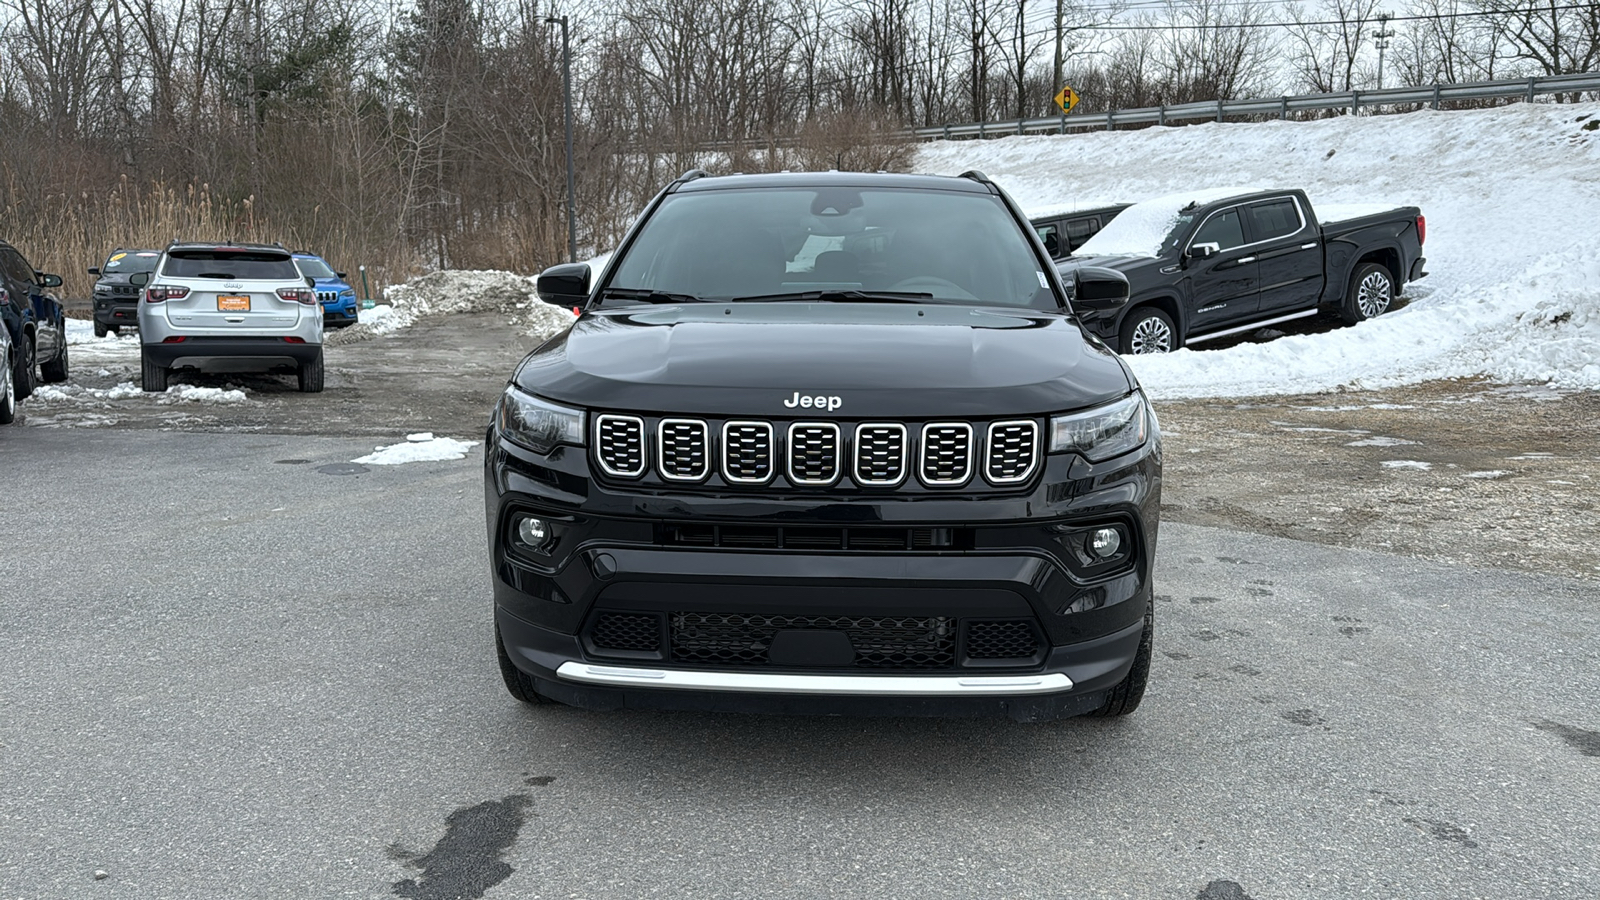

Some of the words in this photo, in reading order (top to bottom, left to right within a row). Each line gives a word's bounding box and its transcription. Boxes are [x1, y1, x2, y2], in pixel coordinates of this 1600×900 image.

[223, 282, 244, 290] Jeep
[1197, 303, 1227, 313] DENALI
[783, 391, 842, 411] Jeep
